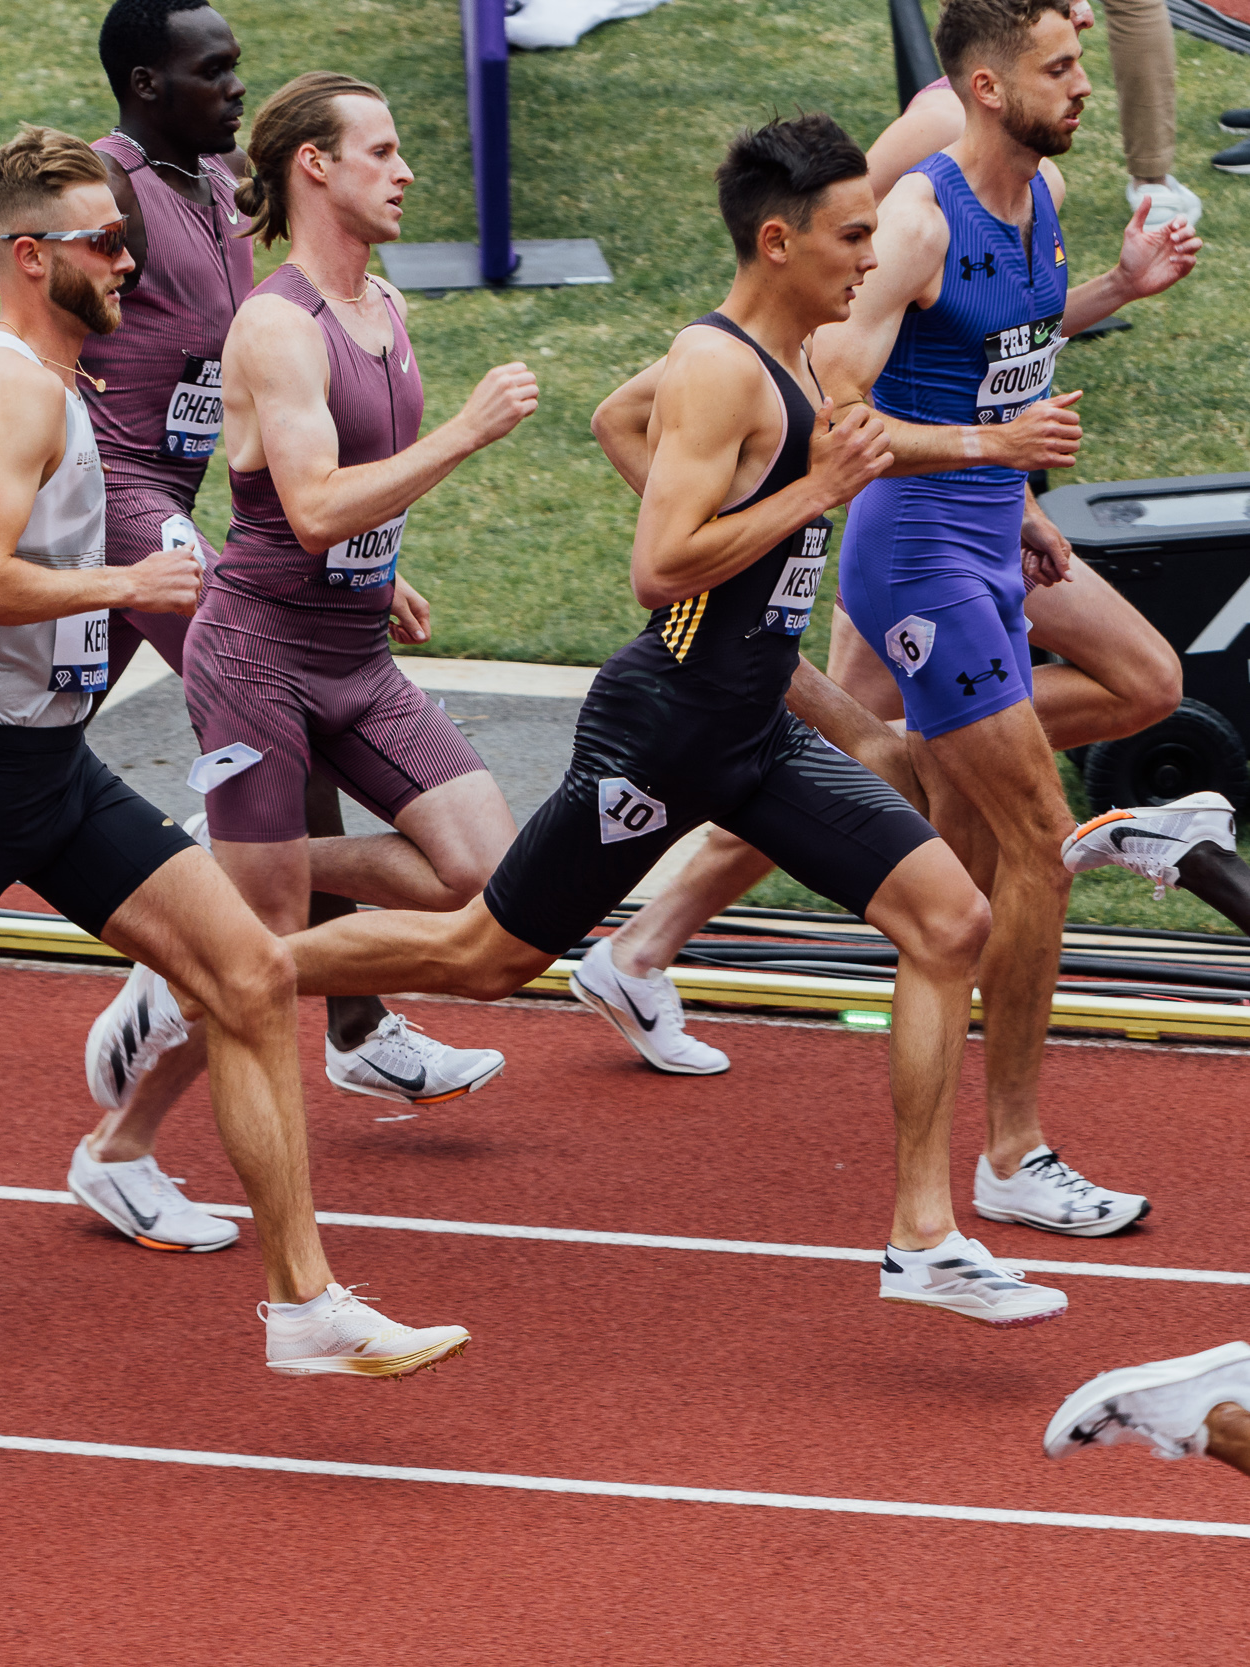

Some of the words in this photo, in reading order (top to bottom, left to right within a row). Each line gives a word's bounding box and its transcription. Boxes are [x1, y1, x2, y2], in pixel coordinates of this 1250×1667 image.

[999, 325, 1030, 359] PRE
[801, 528, 827, 556] PRE
[899, 630, 921, 662] 6
[604, 790, 655, 832] 10
